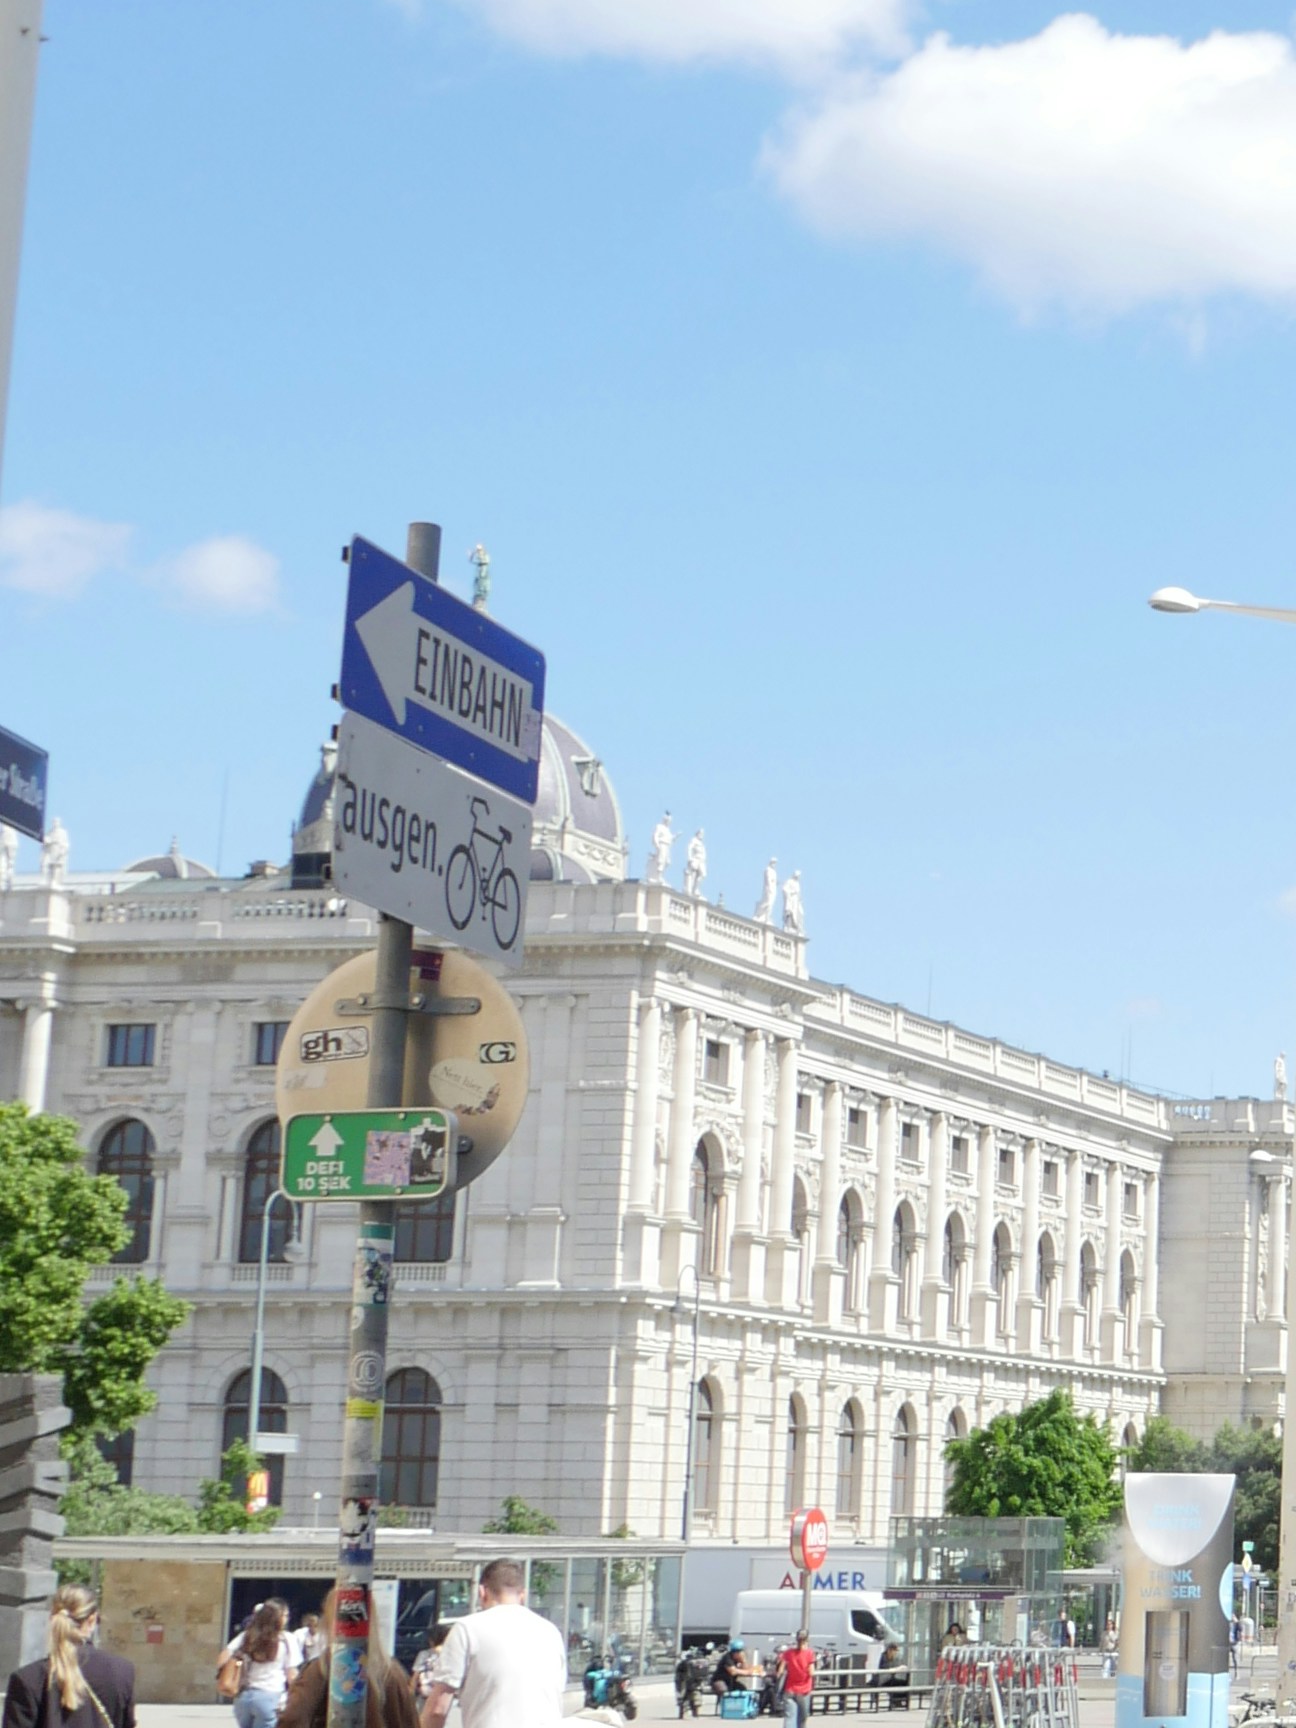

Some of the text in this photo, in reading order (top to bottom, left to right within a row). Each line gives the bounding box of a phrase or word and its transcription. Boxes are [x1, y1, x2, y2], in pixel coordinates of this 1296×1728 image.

[414, 628, 523, 747] EINBAHN
[340, 775, 443, 876] ausgen.
[306, 1161, 344, 1175] DEFI
[297, 1176, 352, 1190] 10 SEK
[806, 1521, 827, 1546] MQ
